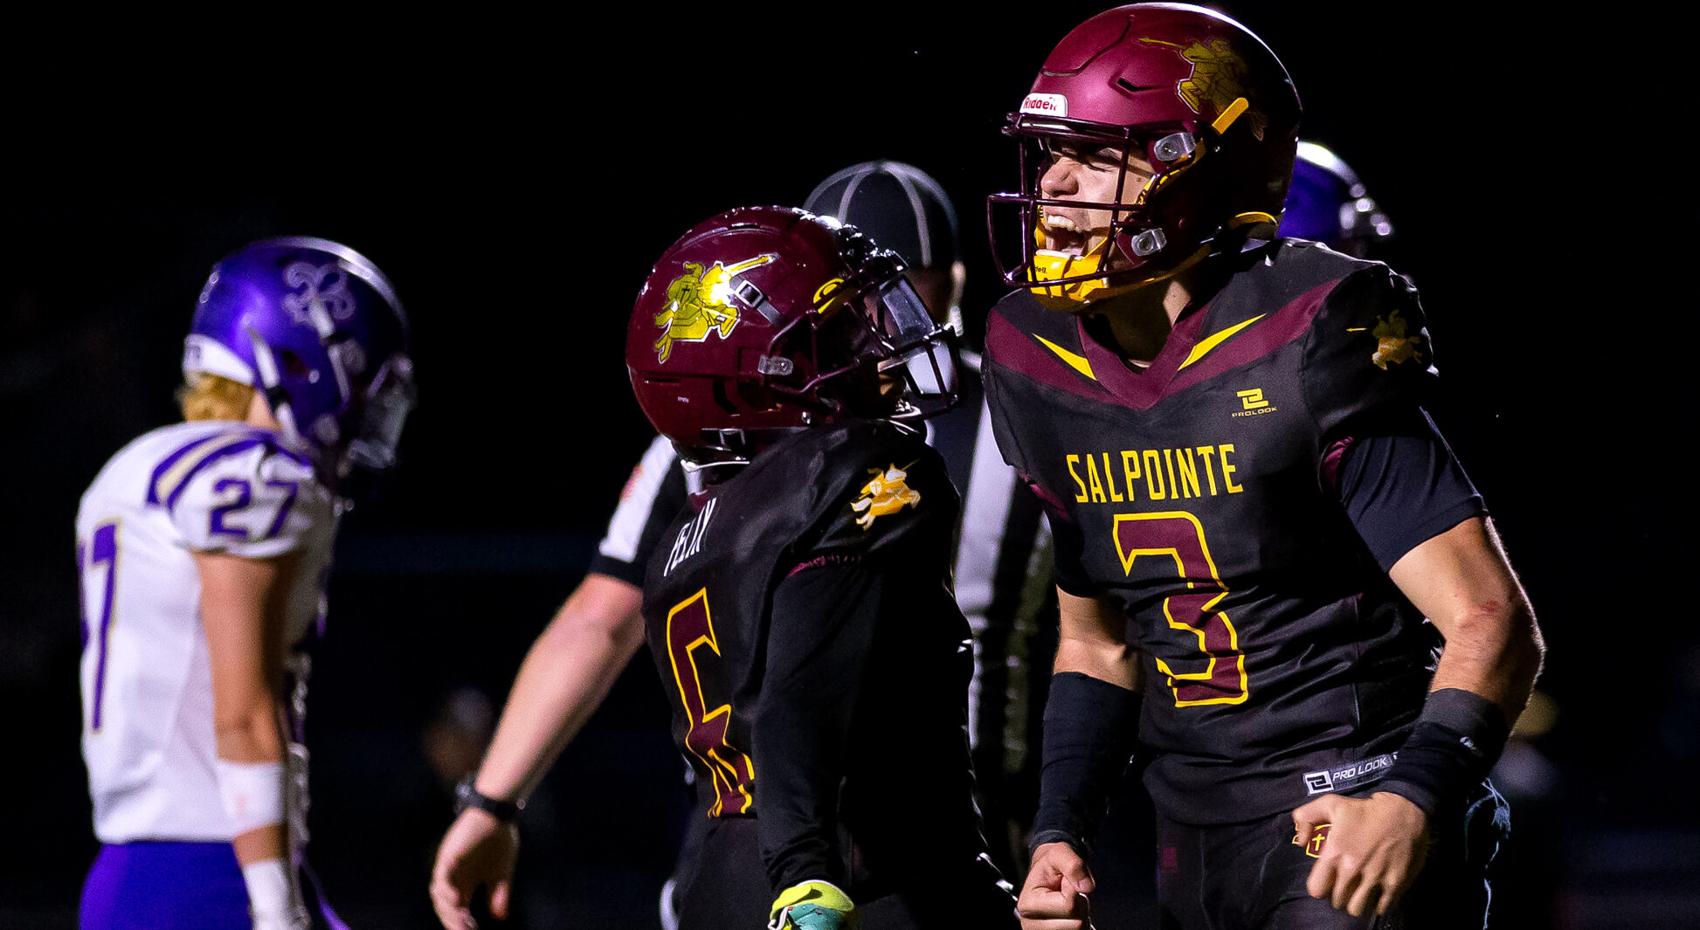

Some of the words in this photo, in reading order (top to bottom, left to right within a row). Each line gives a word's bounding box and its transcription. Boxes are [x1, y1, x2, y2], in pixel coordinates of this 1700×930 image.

[1231, 406, 1278, 417] PROLOOK
[1066, 443, 1243, 504] SALPOINTE
[211, 479, 298, 536] 27
[663, 497, 717, 577] FELIX
[76, 517, 121, 734] 7
[1111, 510, 1249, 708] 3
[1332, 767, 1356, 782] PRO
[1357, 757, 1388, 775] LOOK
